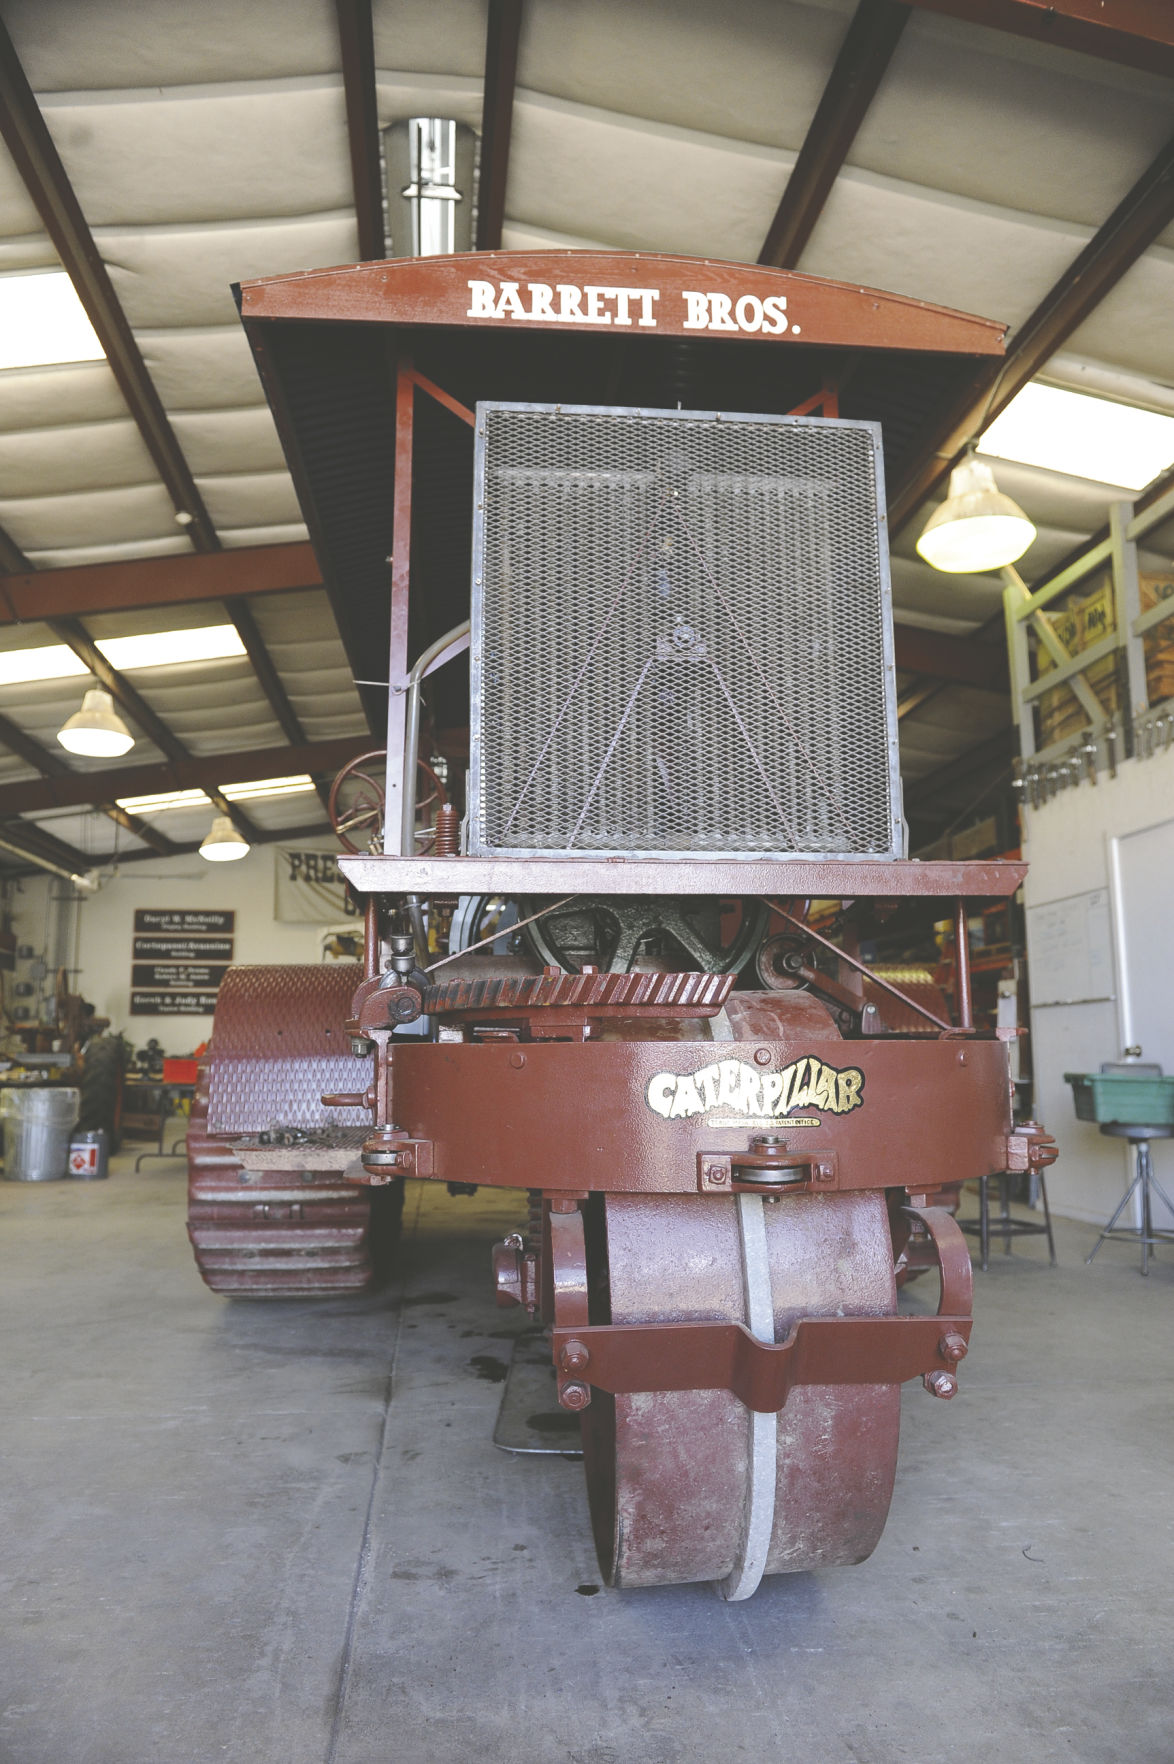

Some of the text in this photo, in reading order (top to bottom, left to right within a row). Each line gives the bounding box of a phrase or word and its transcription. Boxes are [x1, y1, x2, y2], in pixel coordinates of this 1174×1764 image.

[467, 280, 801, 334] BARRETT BROS.
[646, 1056, 864, 1118] CATERPILLAR
